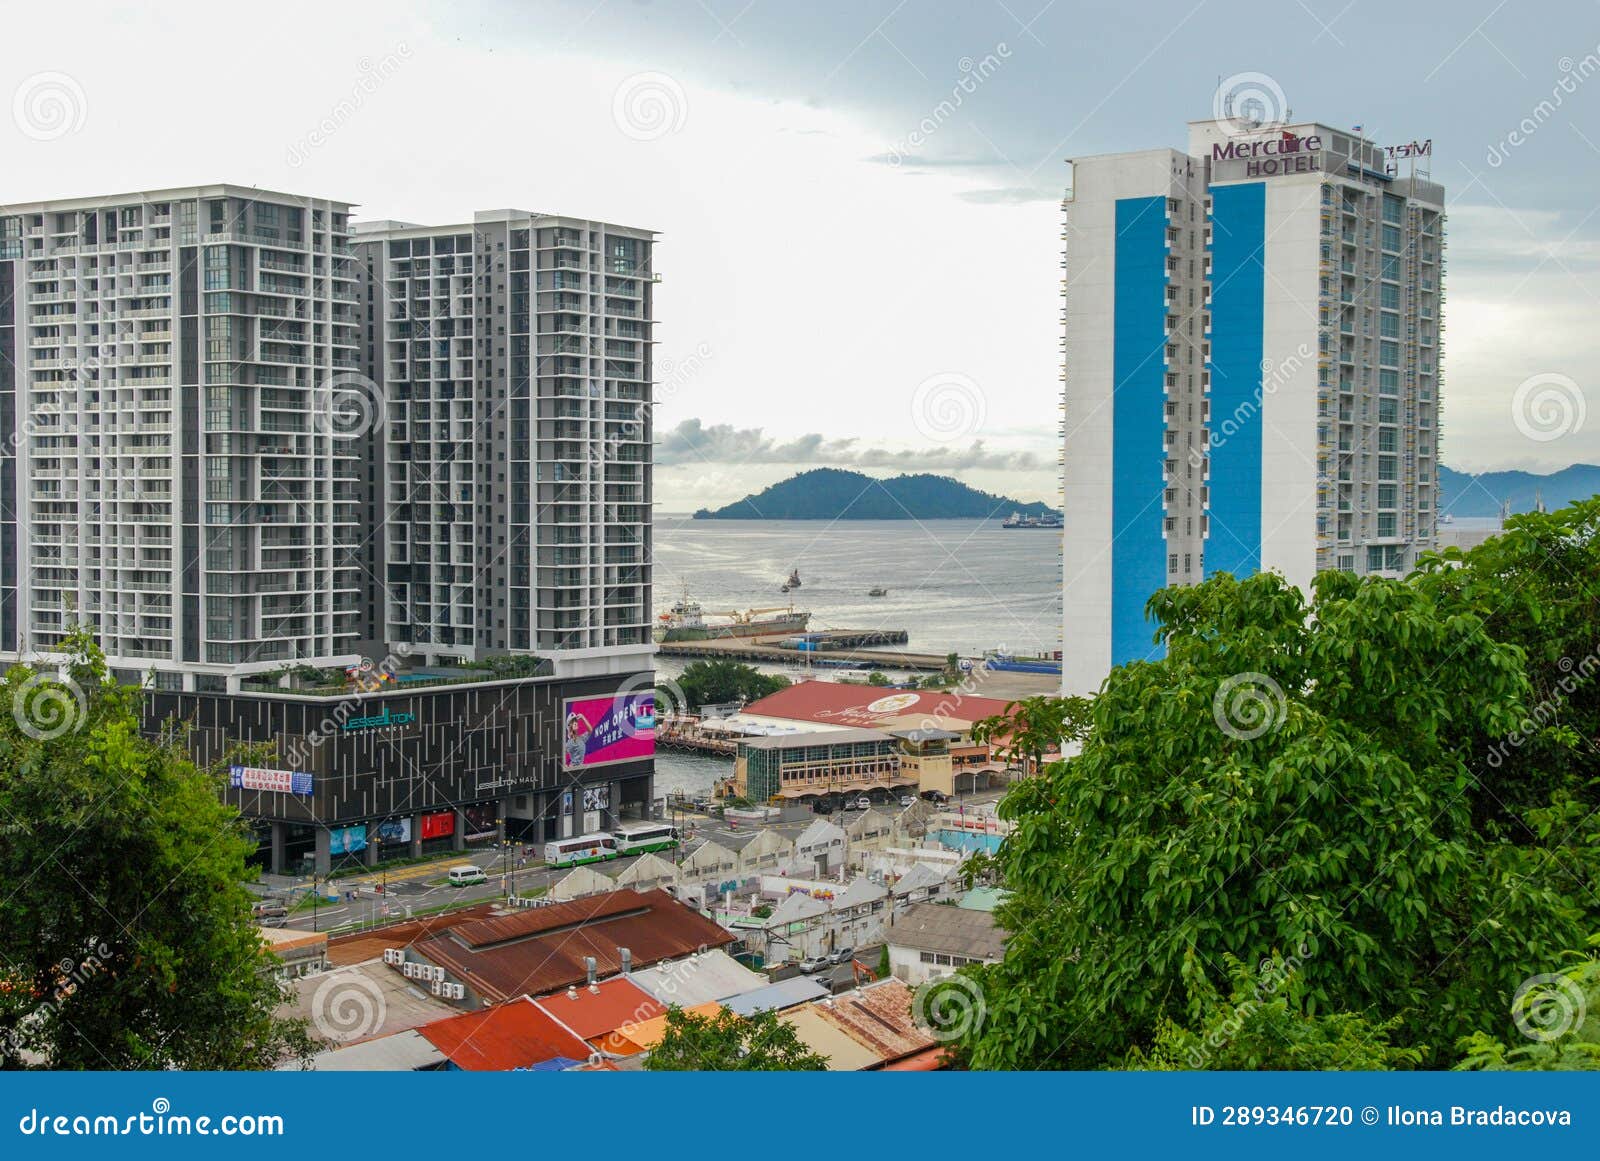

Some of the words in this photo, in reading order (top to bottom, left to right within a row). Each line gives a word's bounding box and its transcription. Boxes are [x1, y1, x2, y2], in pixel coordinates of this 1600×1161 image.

[1213, 134, 1322, 161] Mercure
[1246, 155, 1321, 177] HOTEL
[594, 719, 610, 738] NOW
[612, 700, 637, 727] OPEN
[519, 776, 539, 785] MALL
